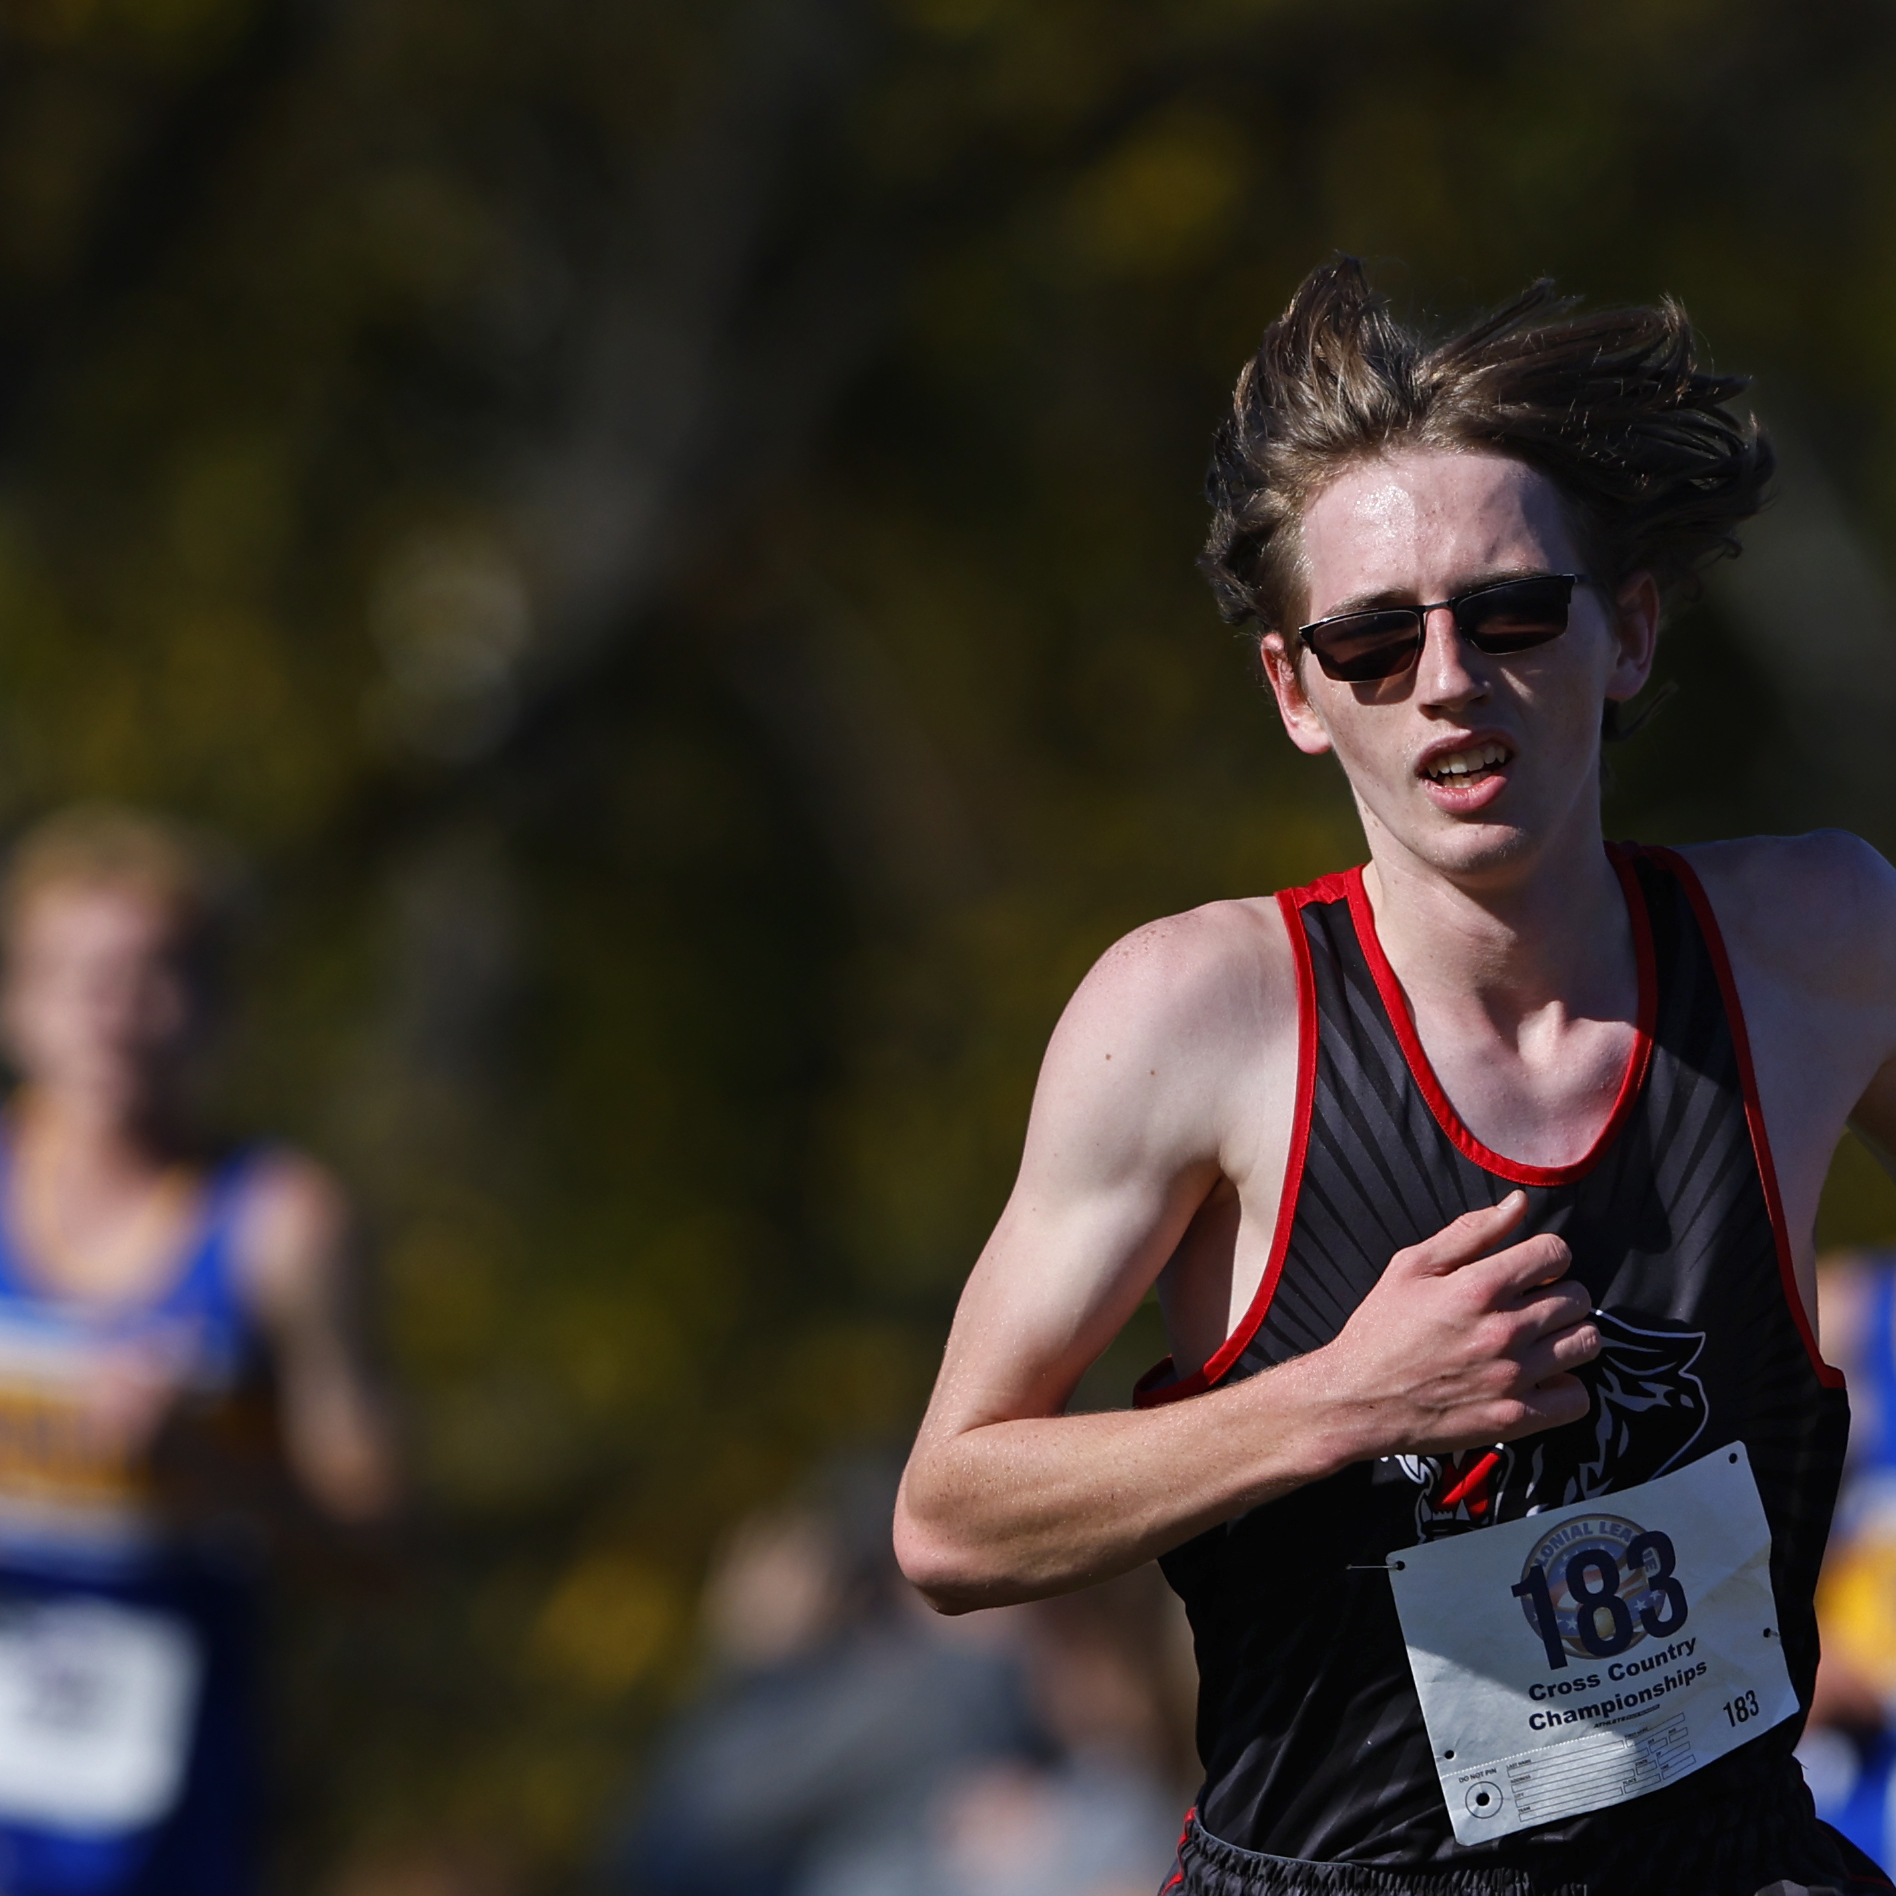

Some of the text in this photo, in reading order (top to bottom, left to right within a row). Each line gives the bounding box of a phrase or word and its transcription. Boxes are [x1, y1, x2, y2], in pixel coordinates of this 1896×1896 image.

[1511, 1530, 1689, 1671] 183
[1528, 1637, 1697, 1701] Cross Country
[1528, 1660, 1708, 1731] Championships
[1722, 1689, 1760, 1728] 183
[1458, 1767, 1497, 1783] DO NOT PIN
